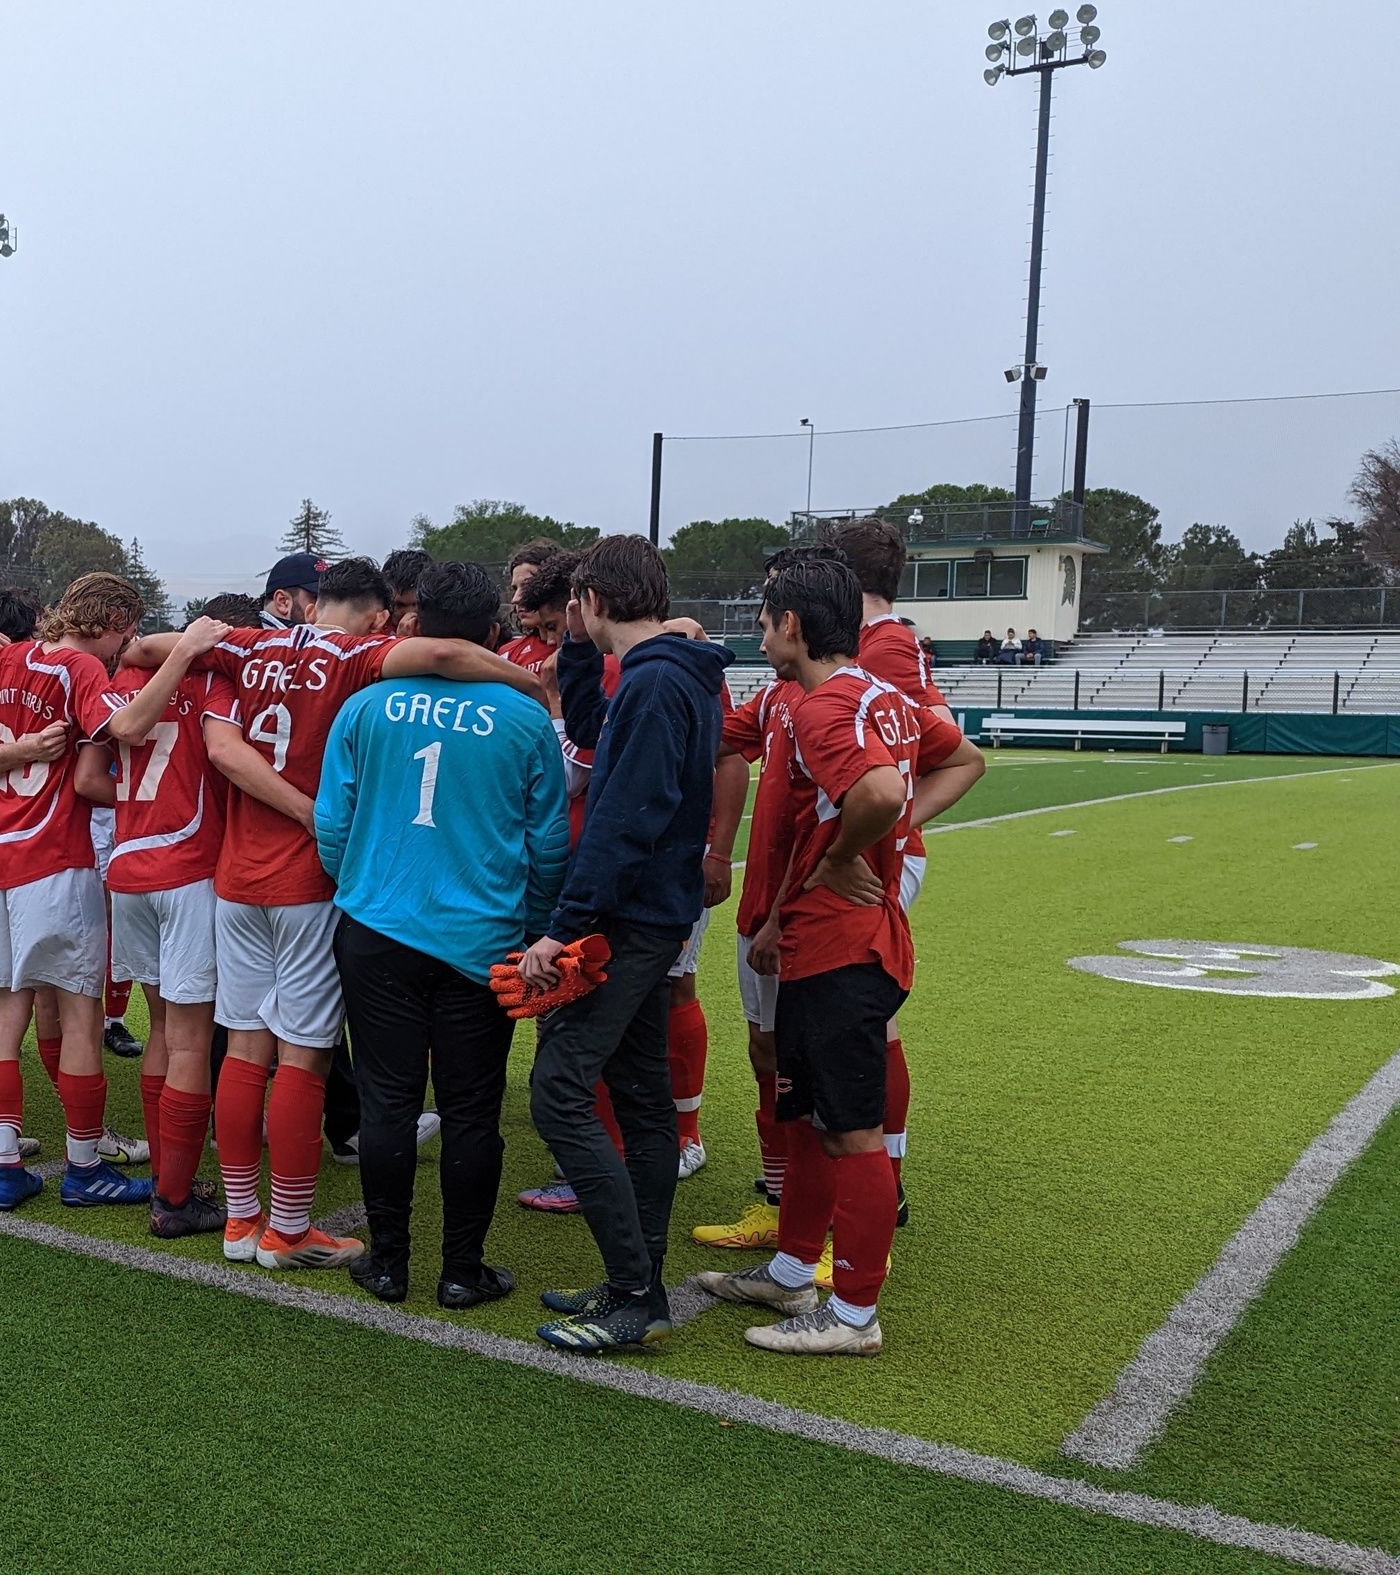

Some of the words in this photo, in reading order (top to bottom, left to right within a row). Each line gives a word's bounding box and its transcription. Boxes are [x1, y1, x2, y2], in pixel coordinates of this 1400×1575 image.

[241, 658, 328, 693] GAELS
[249, 702, 292, 773] 9
[385, 691, 497, 736] GAELS
[116, 721, 179, 801] 17
[411, 741, 442, 828] 1
